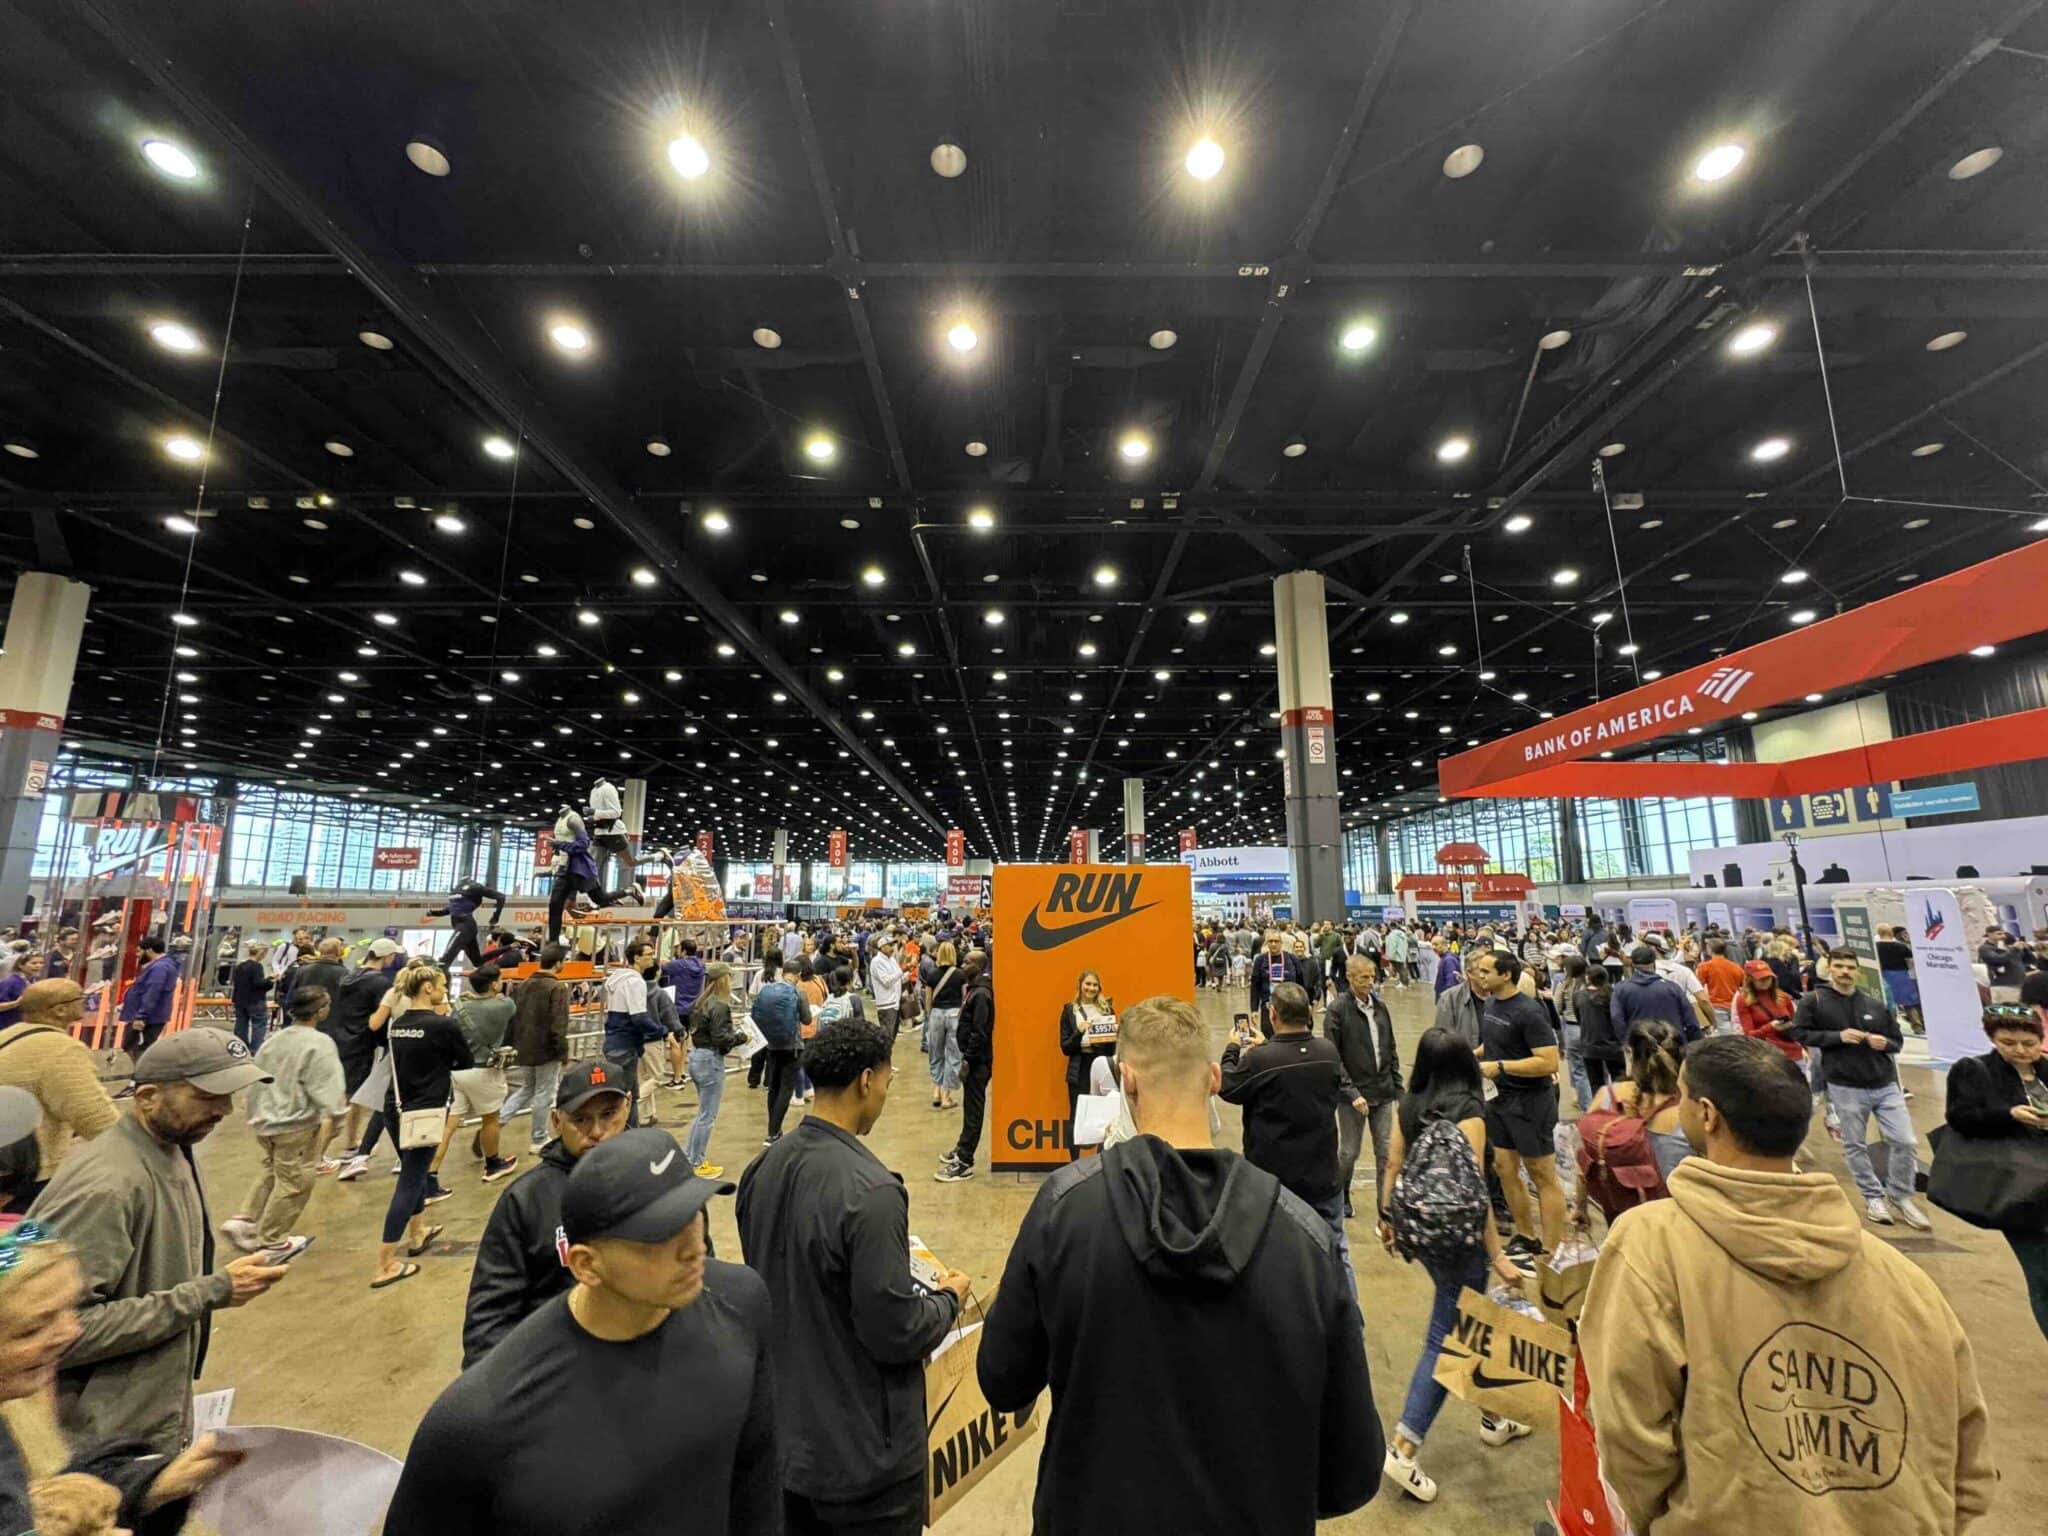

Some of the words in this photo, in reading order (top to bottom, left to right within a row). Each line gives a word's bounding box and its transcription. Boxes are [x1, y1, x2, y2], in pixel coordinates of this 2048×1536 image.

[1524, 734, 1566, 761] BANK
[1570, 726, 1592, 747] OF
[1596, 695, 1695, 740] AMERICA
[833, 840, 841, 865] 300
[951, 839, 959, 865] 400
[1199, 855, 1240, 868] Abbott
[256, 911, 295, 923] ROAD
[298, 911, 346, 923] RACING
[1045, 872, 1144, 914] RUN
[1509, 1334, 1568, 1389] NIKE
[1767, 1349, 1878, 1406] SAND
[932, 1405, 1010, 1499] NIKE
[1777, 1411, 1882, 1476] JAMM
